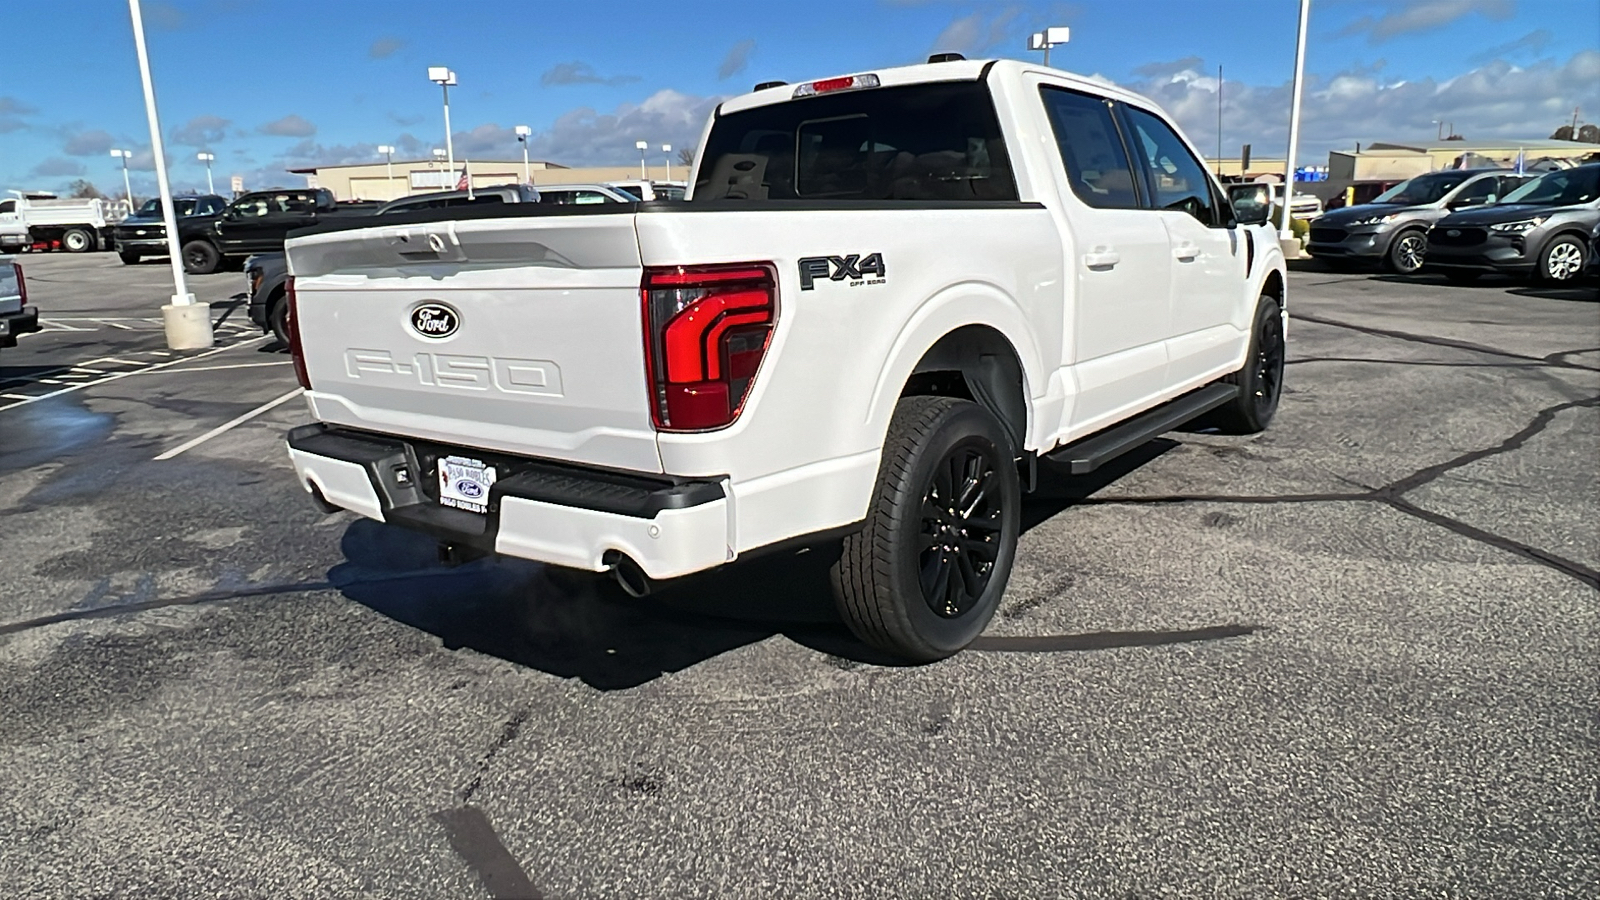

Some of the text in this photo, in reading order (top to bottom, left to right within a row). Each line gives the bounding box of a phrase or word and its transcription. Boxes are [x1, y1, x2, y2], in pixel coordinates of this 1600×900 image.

[797, 252, 886, 291] FX4
[418, 308, 450, 332] Ford
[344, 347, 565, 398] F-150
[461, 482, 479, 496] Ford
